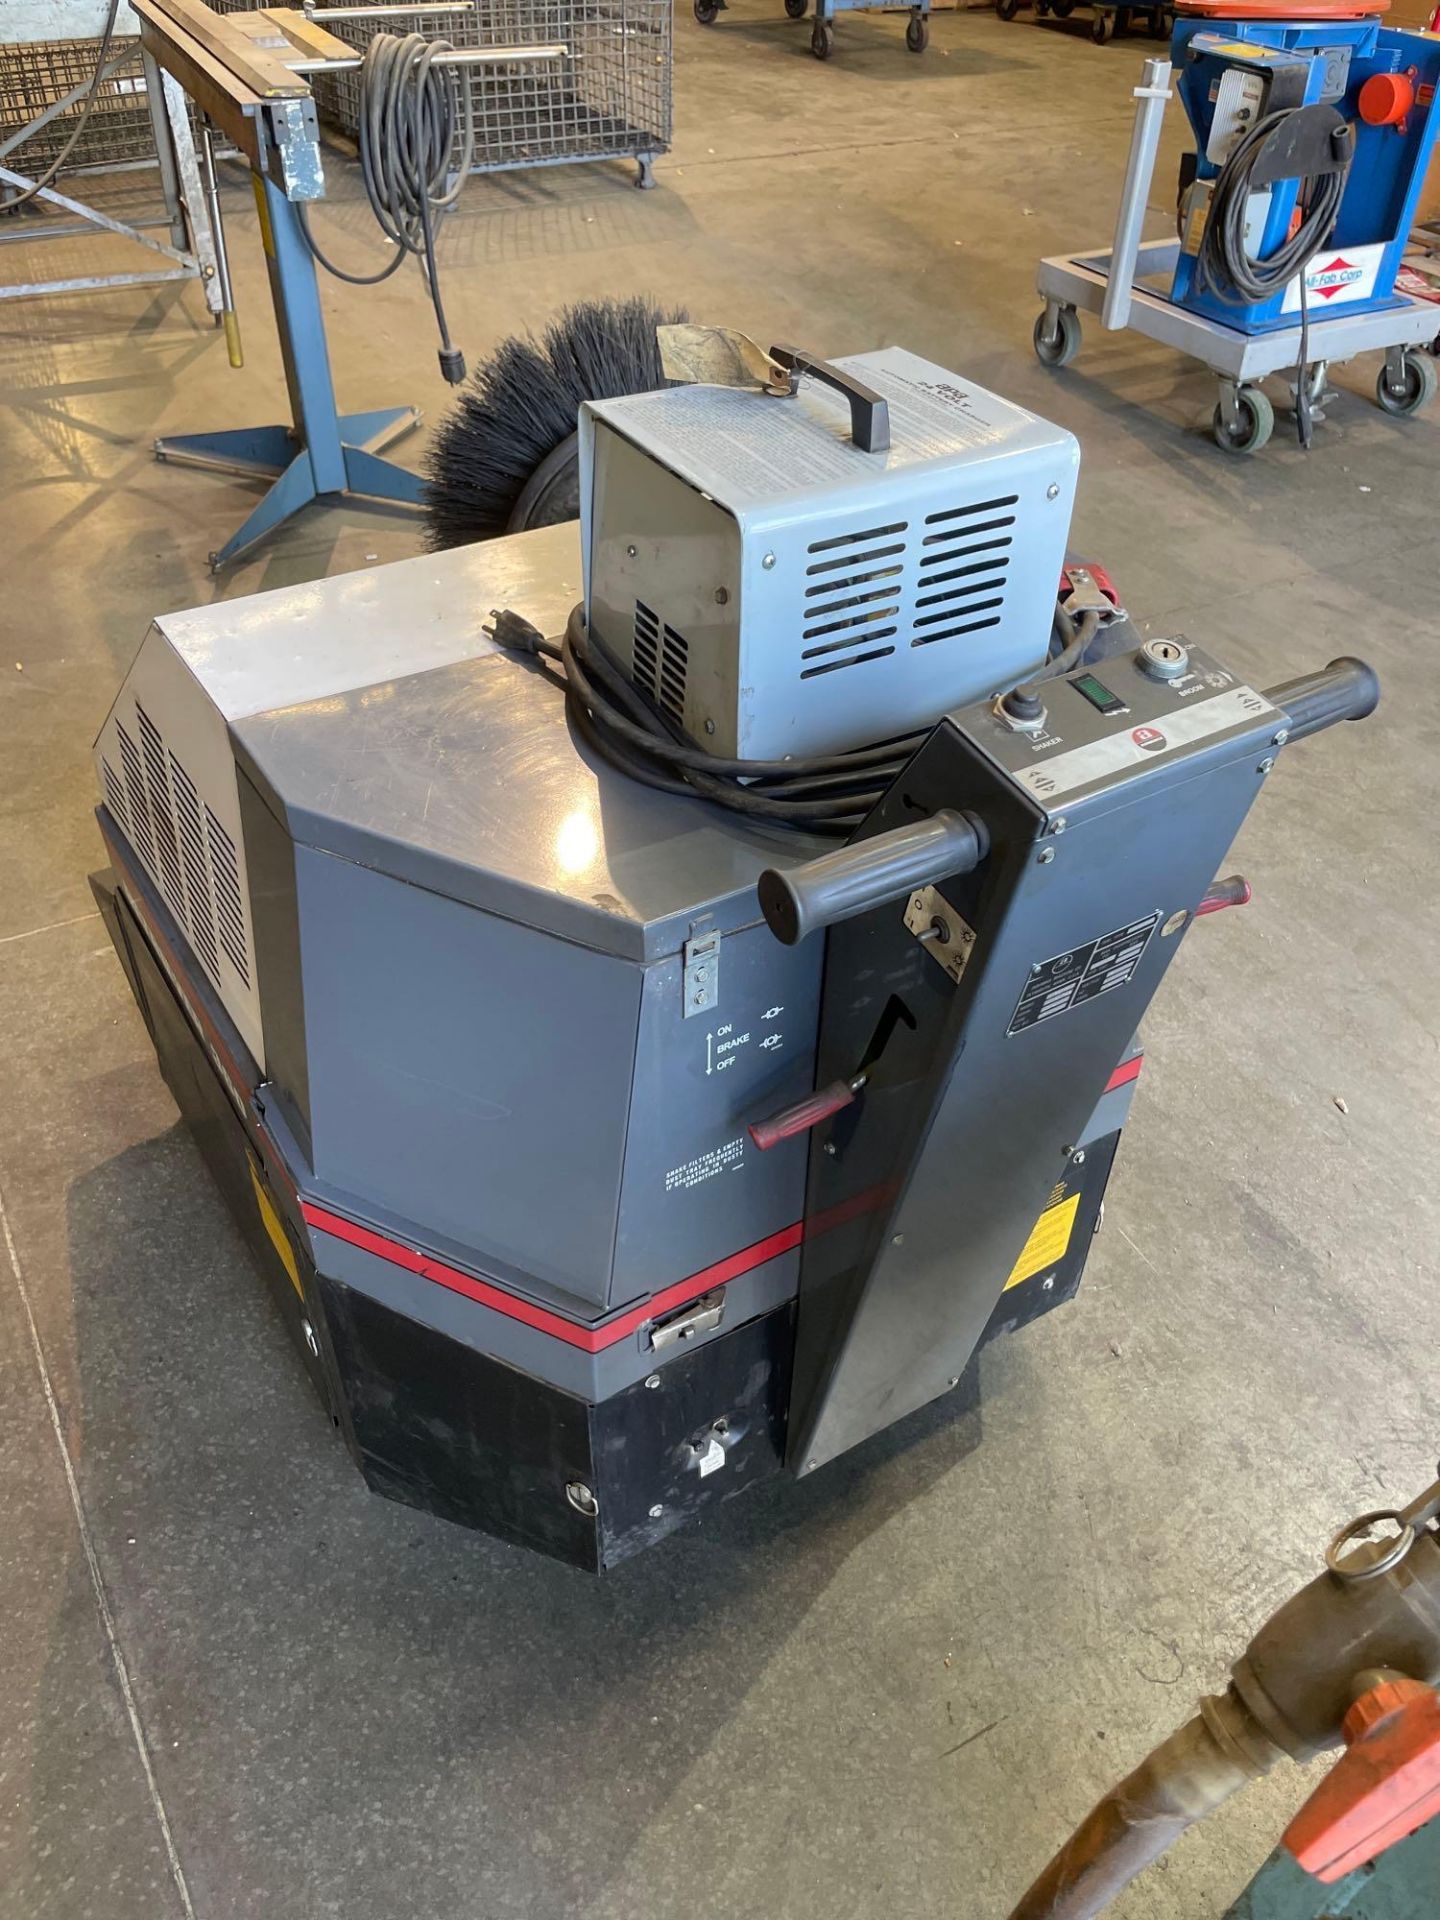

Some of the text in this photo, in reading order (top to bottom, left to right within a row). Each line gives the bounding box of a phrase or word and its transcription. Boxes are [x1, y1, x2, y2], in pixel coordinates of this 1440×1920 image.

[1340, 269, 1363, 282] Corp
[937, 390, 973, 408] VOLT
[1178, 684, 1206, 697] BROOM
[1031, 736, 1064, 752] SHAKER
[717, 1023, 733, 1037] ON
[717, 1032, 751, 1054] BRAKE
[716, 1055, 737, 1070] OFF
[665, 1164, 687, 1178] SHAKE
[688, 1151, 715, 1167] FILTERS
[722, 1137, 744, 1151] EMPTY
[665, 1143, 744, 1185] DUST TRAY FREQUENTLY
[665, 1183, 673, 1192] IF
[674, 1166, 710, 1188] OPERATING
[712, 1161, 720, 1169] IN
[723, 1149, 744, 1164] DUSTY
[685, 1165, 723, 1188] CONDITIONS
